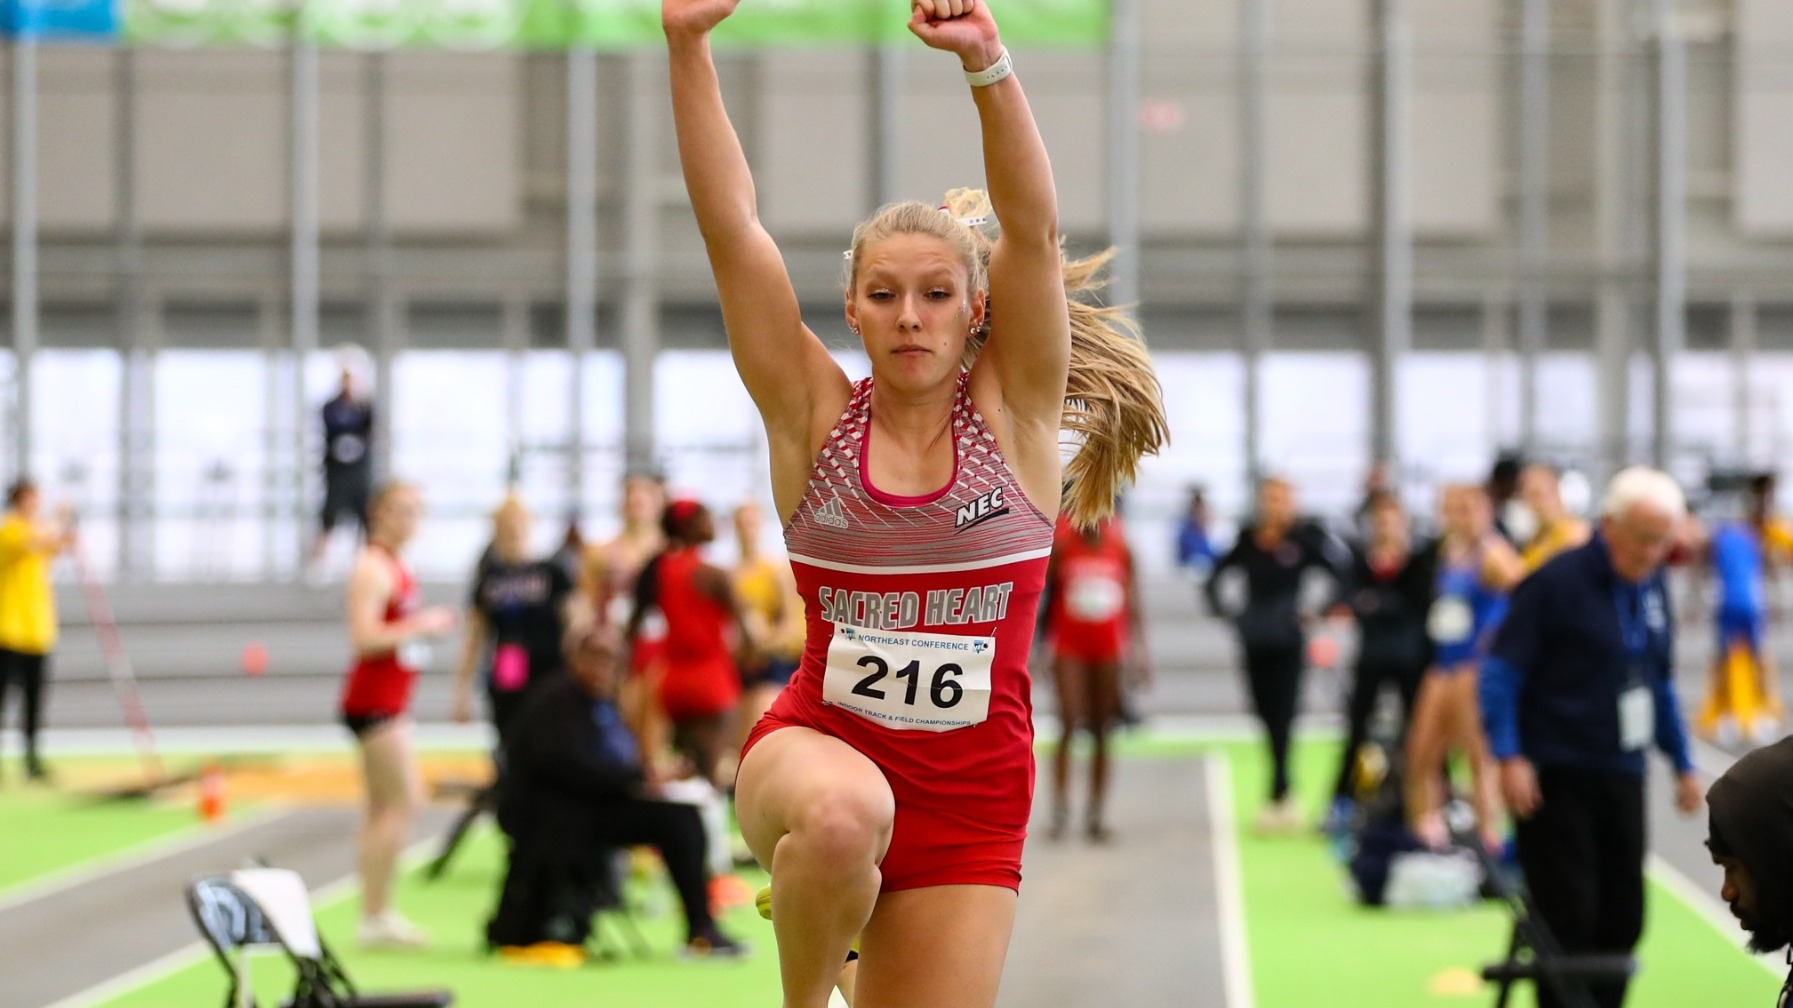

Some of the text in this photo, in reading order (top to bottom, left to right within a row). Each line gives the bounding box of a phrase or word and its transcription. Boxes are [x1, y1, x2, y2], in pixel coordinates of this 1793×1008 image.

[814, 513, 849, 529] adidas
[955, 487, 1004, 528] NEC
[818, 582, 1013, 630] SACRED HEART
[858, 635, 969, 650] NORTHEAST CONFERENCE
[851, 655, 963, 708] 216
[837, 701, 863, 713] INDOOR
[864, 710, 887, 719] TRACK
[894, 715, 914, 724] FIELD
[915, 718, 971, 726] CHAMPIONSHIPS
